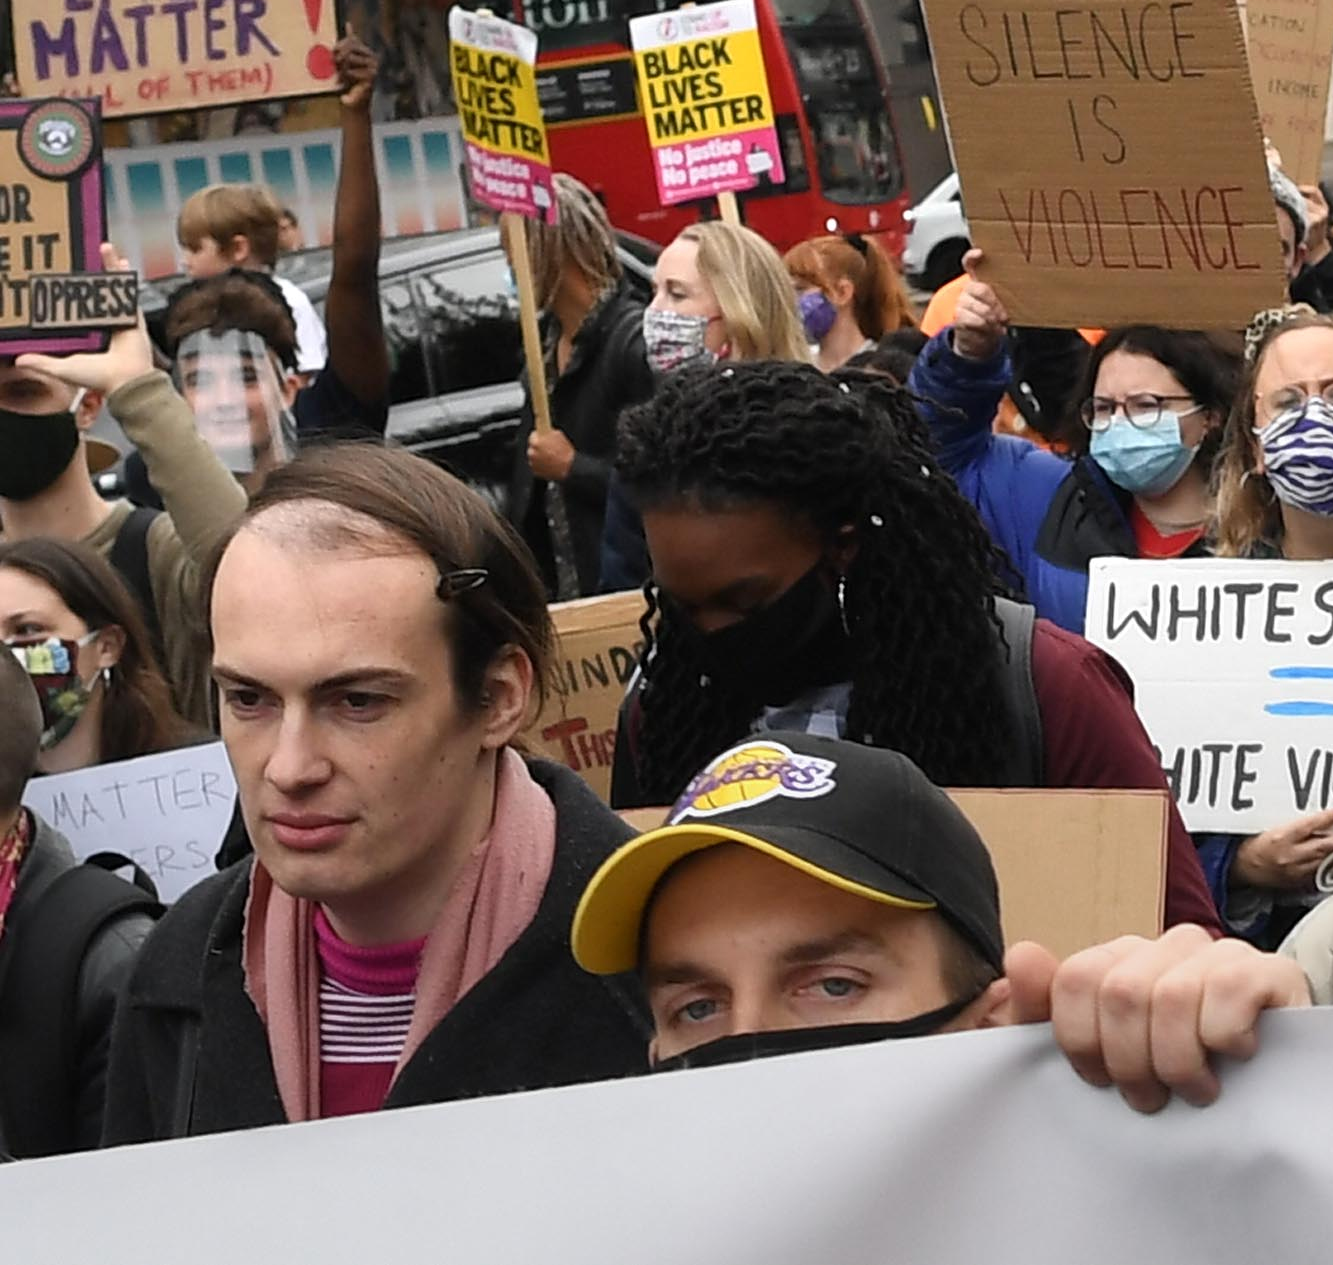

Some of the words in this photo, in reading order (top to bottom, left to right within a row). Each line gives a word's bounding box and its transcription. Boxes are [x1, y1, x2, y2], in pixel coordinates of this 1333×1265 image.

[643, 38, 732, 80] BLACK
[959, 0, 1205, 87] SILENCE
[138, 77, 170, 100] OF
[186, 63, 273, 96] THEM)
[453, 46, 523, 89] BLACK
[458, 75, 515, 117] LIVES
[648, 71, 723, 109] LIVES
[462, 108, 544, 158] MATTER
[653, 94, 766, 139] MATTER
[1068, 94, 1128, 164] IS
[658, 146, 683, 166] No
[685, 138, 742, 167] justice
[662, 167, 686, 186] No
[689, 159, 738, 186] peace
[998, 185, 1261, 271] VIOLENCE
[23, 234, 60, 270] IT
[33, 279, 137, 323] OPPRESS
[1106, 583, 1299, 643] WHITE
[52, 769, 231, 829] MATTER
[1156, 744, 1262, 811] HITE
[129, 841, 210, 877] ERS
